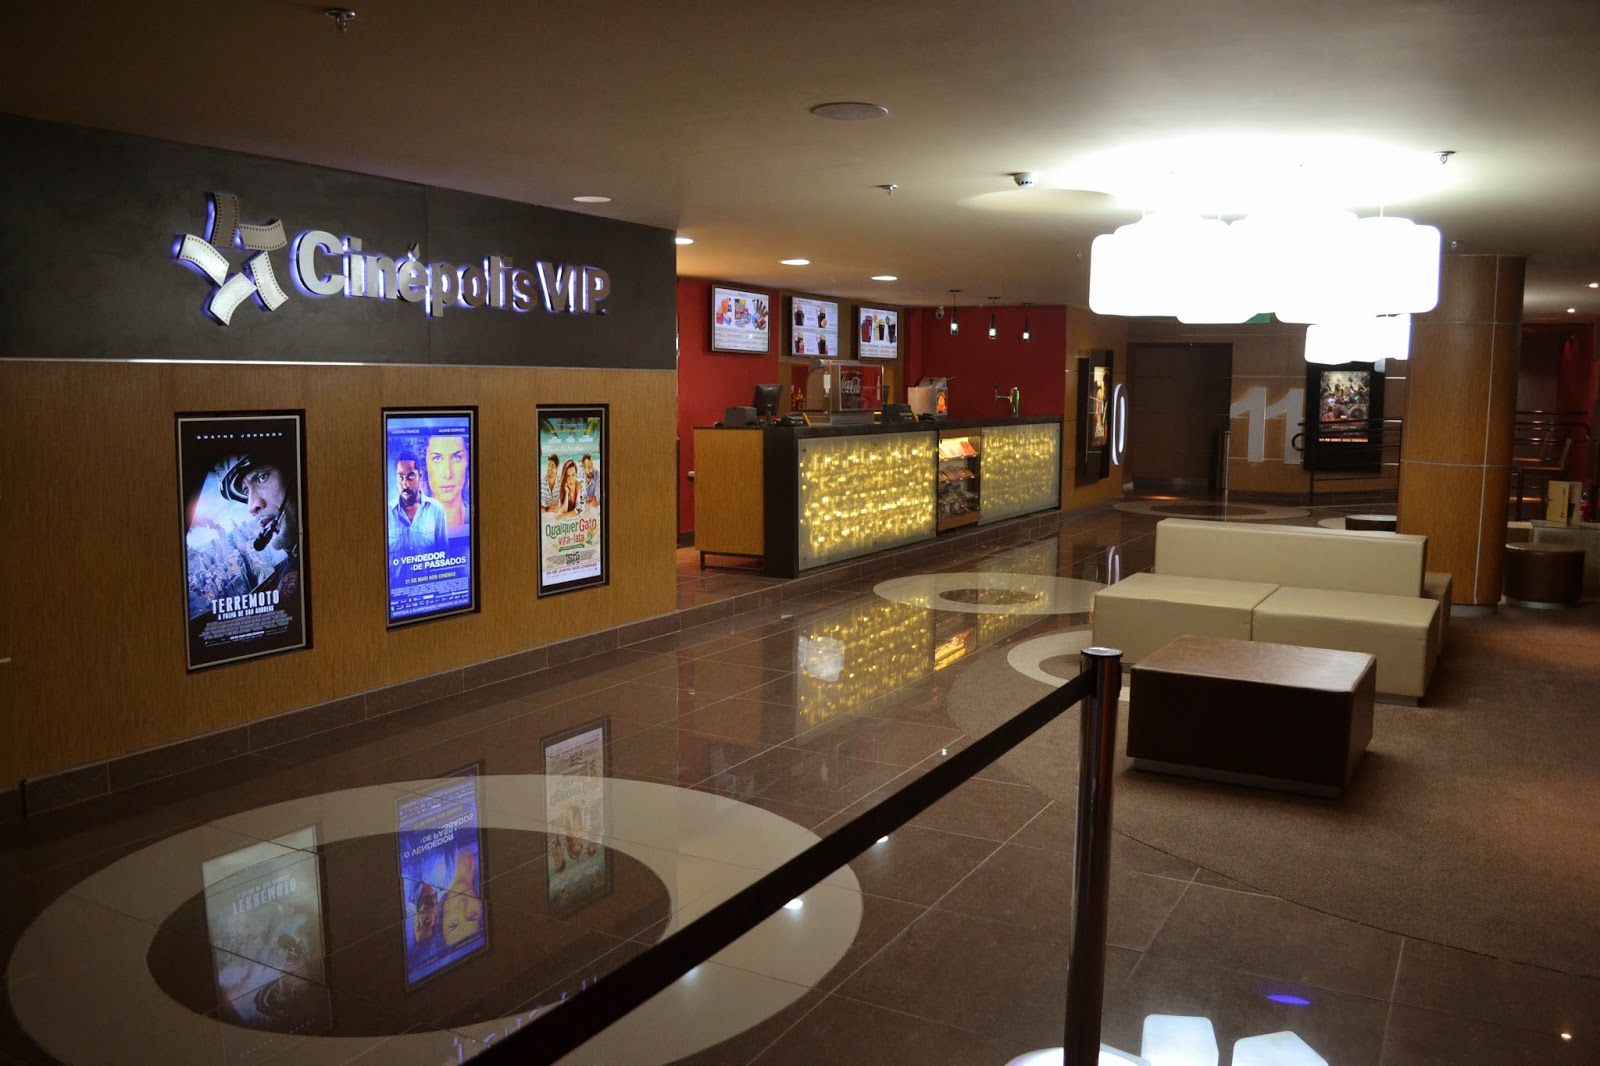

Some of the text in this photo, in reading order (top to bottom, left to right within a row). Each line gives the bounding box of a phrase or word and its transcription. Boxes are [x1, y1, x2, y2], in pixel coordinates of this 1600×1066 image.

[297, 230, 537, 317] Cinépolis
[1230, 386, 1304, 465] 11
[545, 517, 597, 540] Qualquer Gato
[392, 551, 446, 566] O VENDEDOR
[413, 556, 467, 571] DE PASSADOS
[211, 589, 280, 615] TERREMOTO
